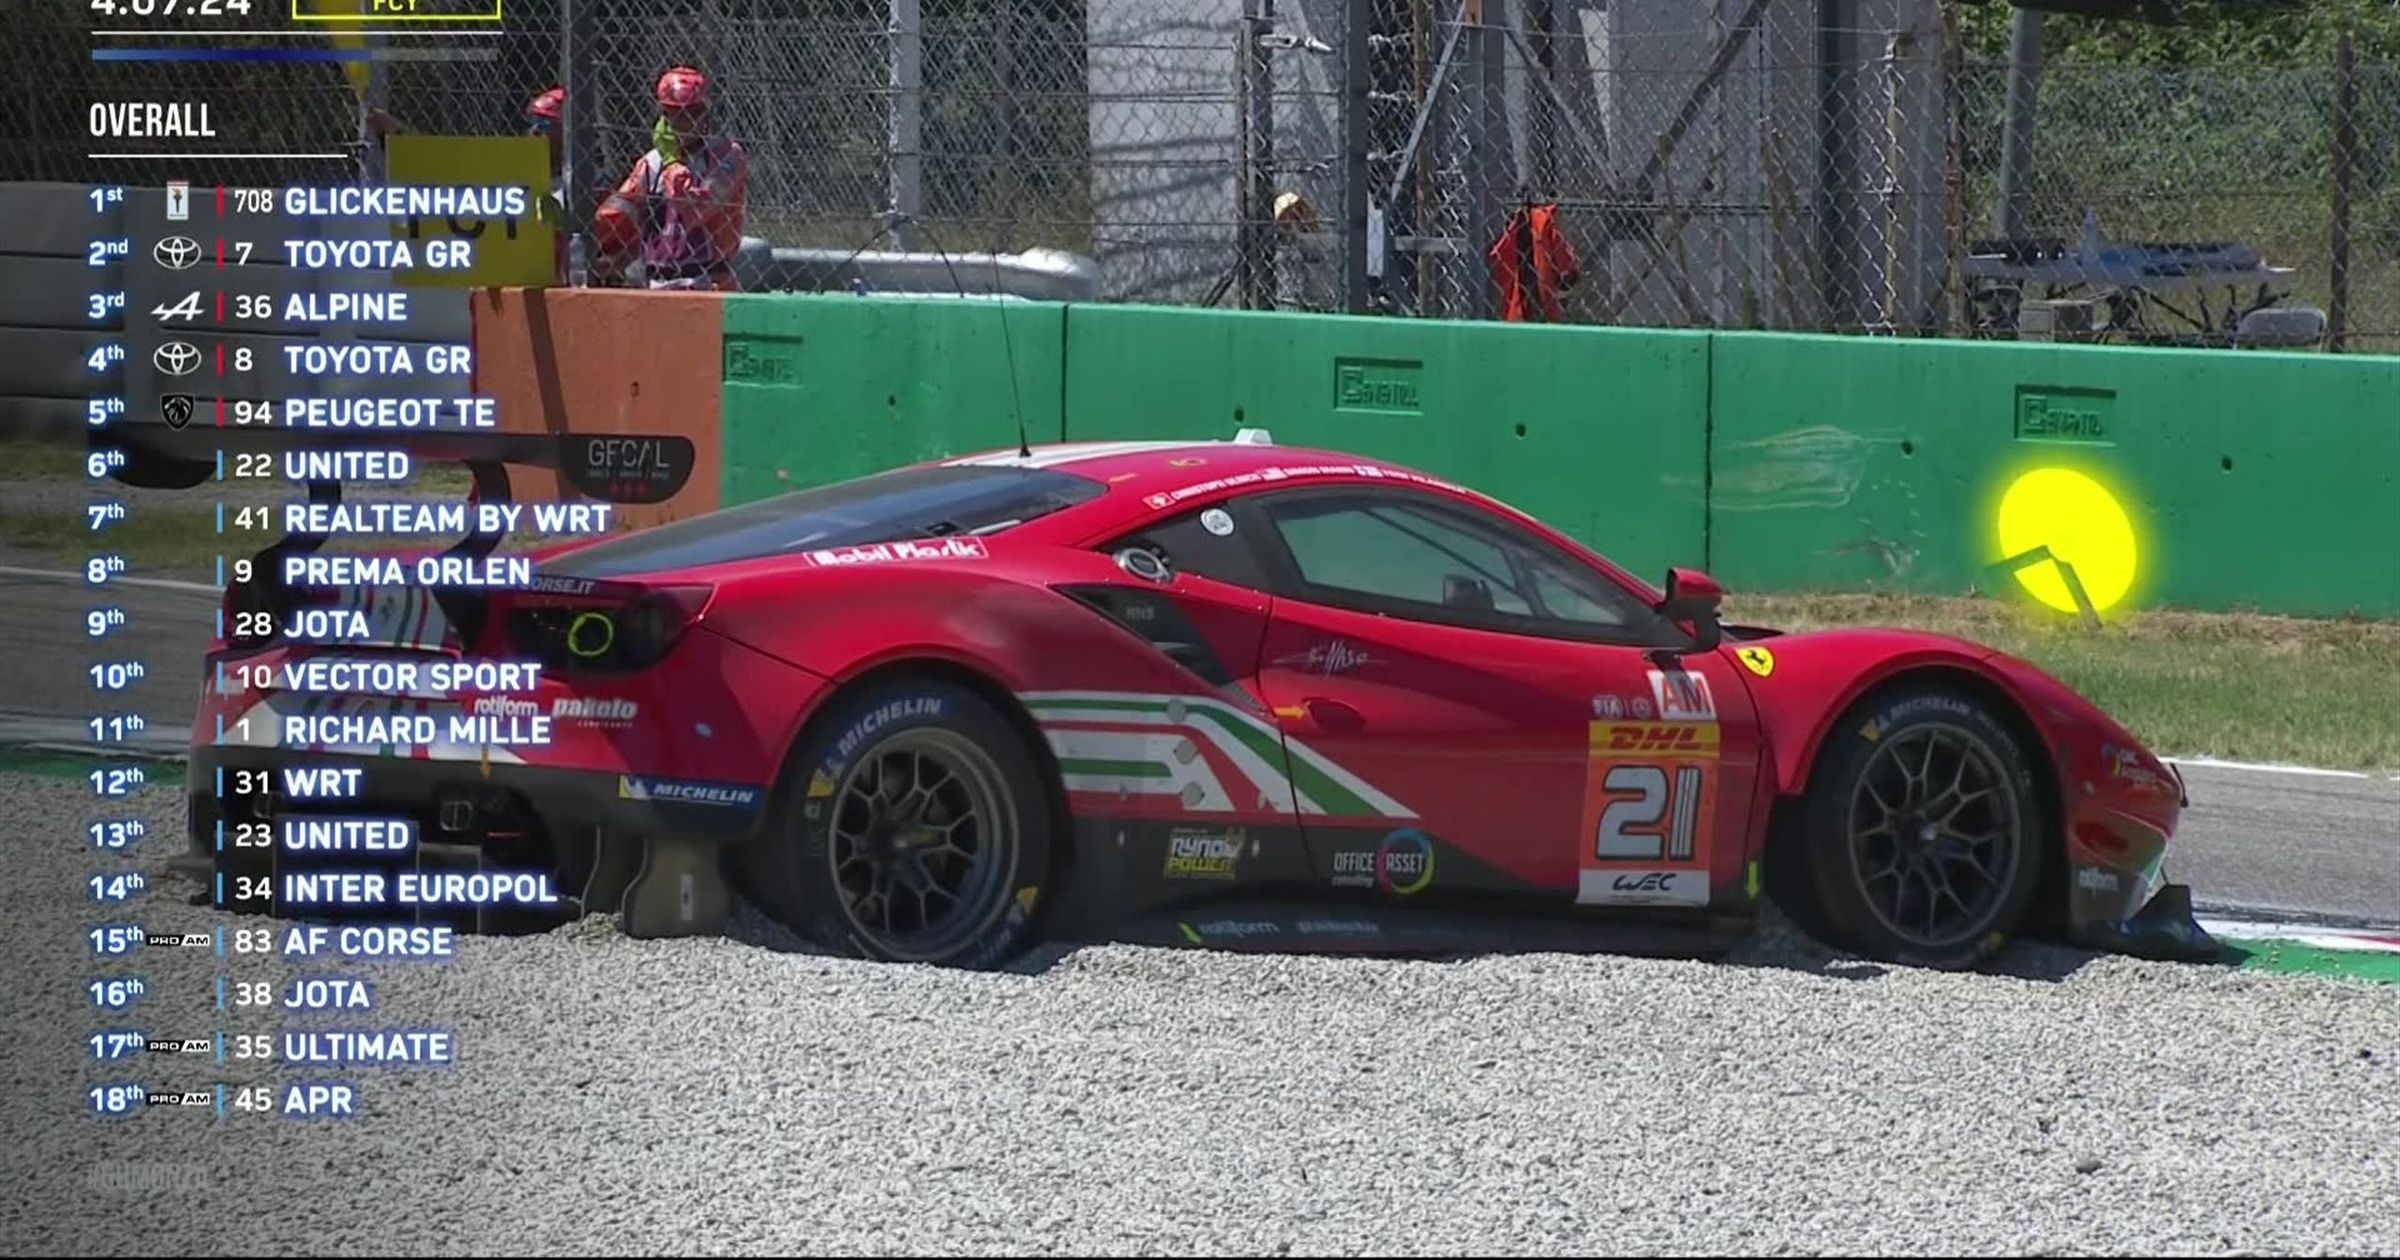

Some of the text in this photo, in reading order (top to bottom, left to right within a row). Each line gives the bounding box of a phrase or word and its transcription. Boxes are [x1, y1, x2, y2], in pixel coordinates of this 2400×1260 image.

[1661, 676, 1712, 715] AM
[838, 698, 943, 757] MICHELIN
[1609, 727, 1699, 750] DHL
[653, 783, 753, 803] MICHELIN
[1595, 764, 1703, 861] 21
[1333, 852, 1424, 873] OFFICE ASSET
[1612, 872, 1677, 891] WEC
